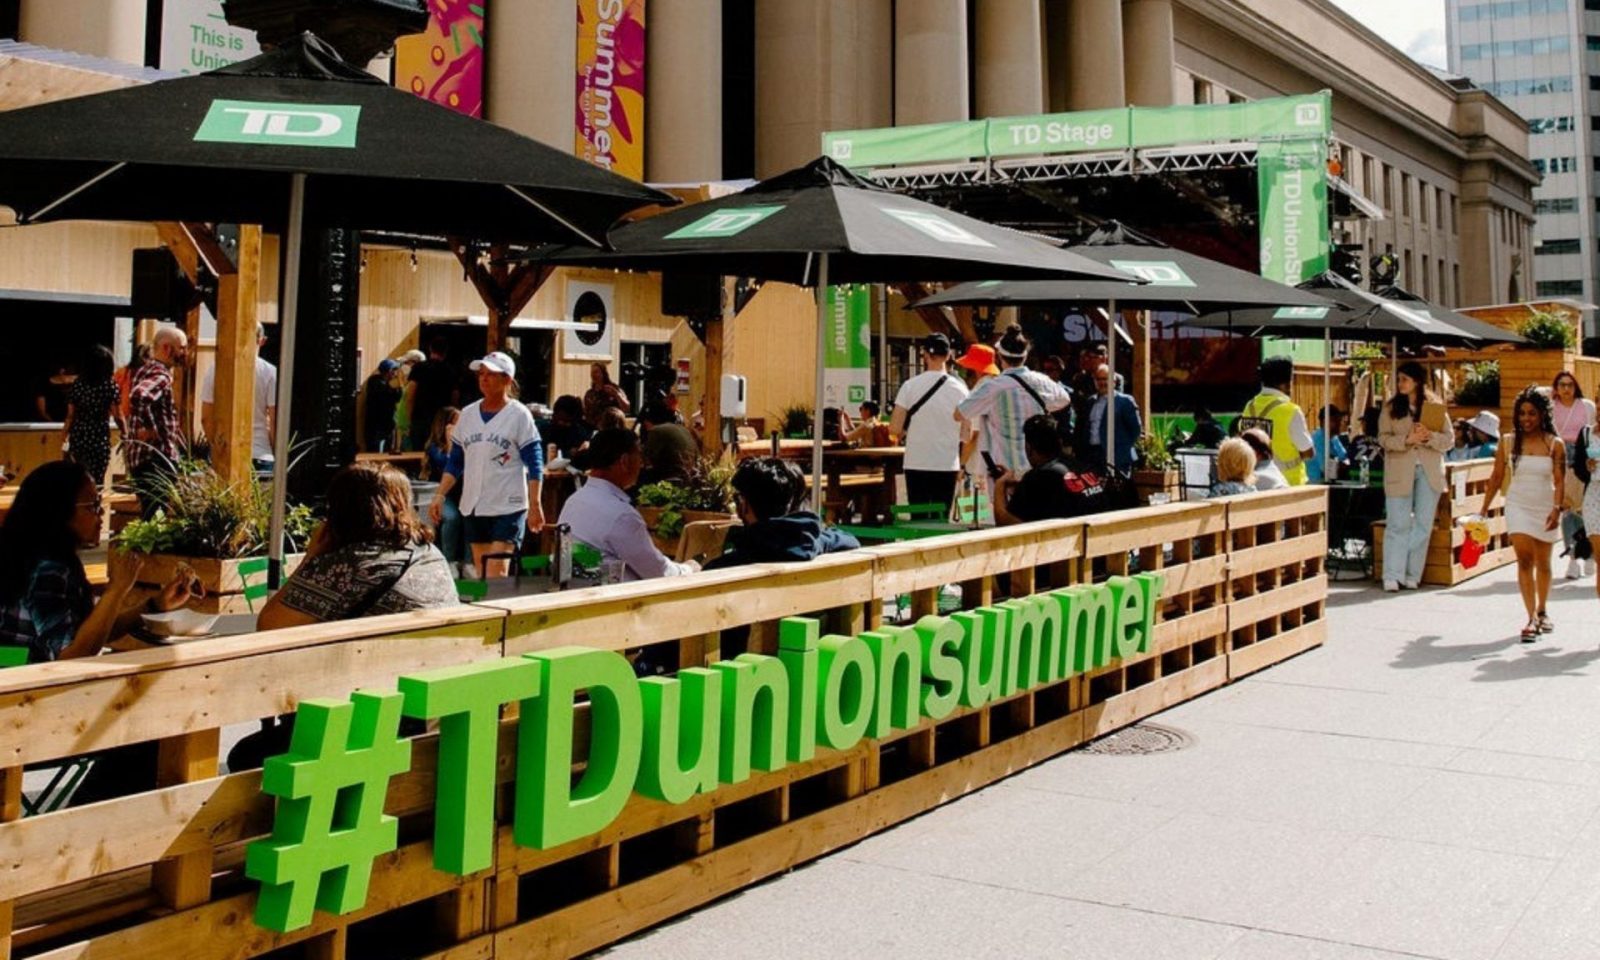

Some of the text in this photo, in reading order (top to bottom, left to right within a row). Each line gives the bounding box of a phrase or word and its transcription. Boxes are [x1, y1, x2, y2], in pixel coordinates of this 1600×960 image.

[190, 24, 244, 51] This is
[191, 48, 239, 69] Unio
[594, 0, 623, 172] Summer
[224, 108, 342, 137] TD
[1009, 121, 1113, 146] TD Stage
[694, 213, 763, 232] TD
[834, 285, 847, 354] ummer
[246, 571, 1164, 933] #TDunionsummer
